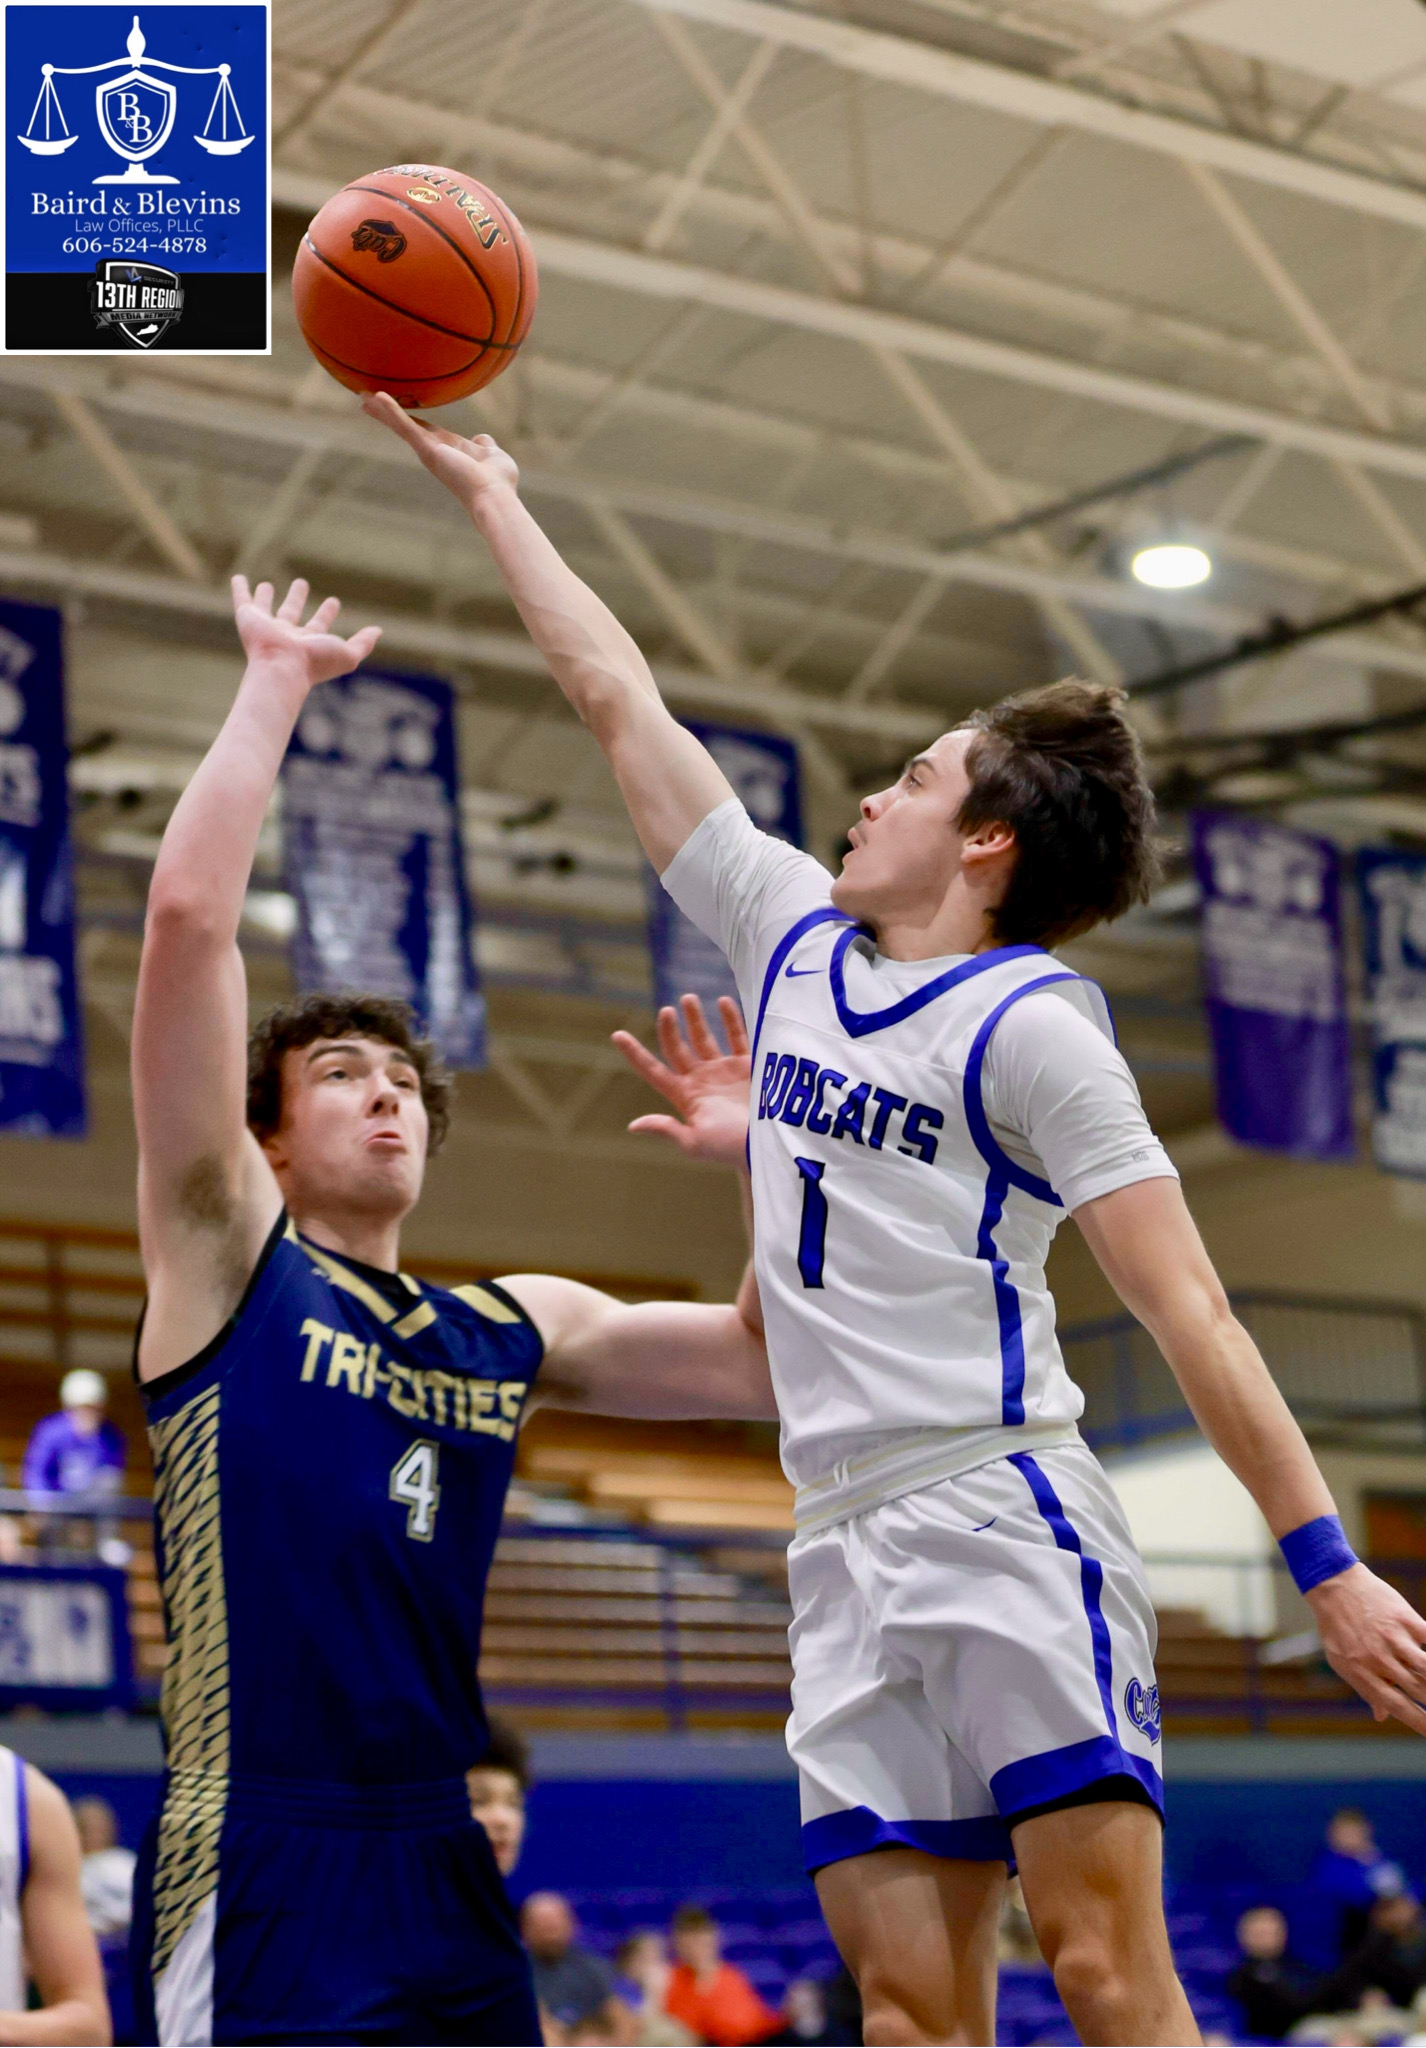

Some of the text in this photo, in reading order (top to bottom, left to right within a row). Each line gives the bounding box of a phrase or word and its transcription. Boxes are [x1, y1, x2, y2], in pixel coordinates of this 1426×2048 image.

[758, 1052, 944, 1165] BOBCATS
[794, 1156, 828, 1289] 1
[300, 1318, 527, 1442] TRI-CITIES
[389, 1438, 441, 1543] 4
